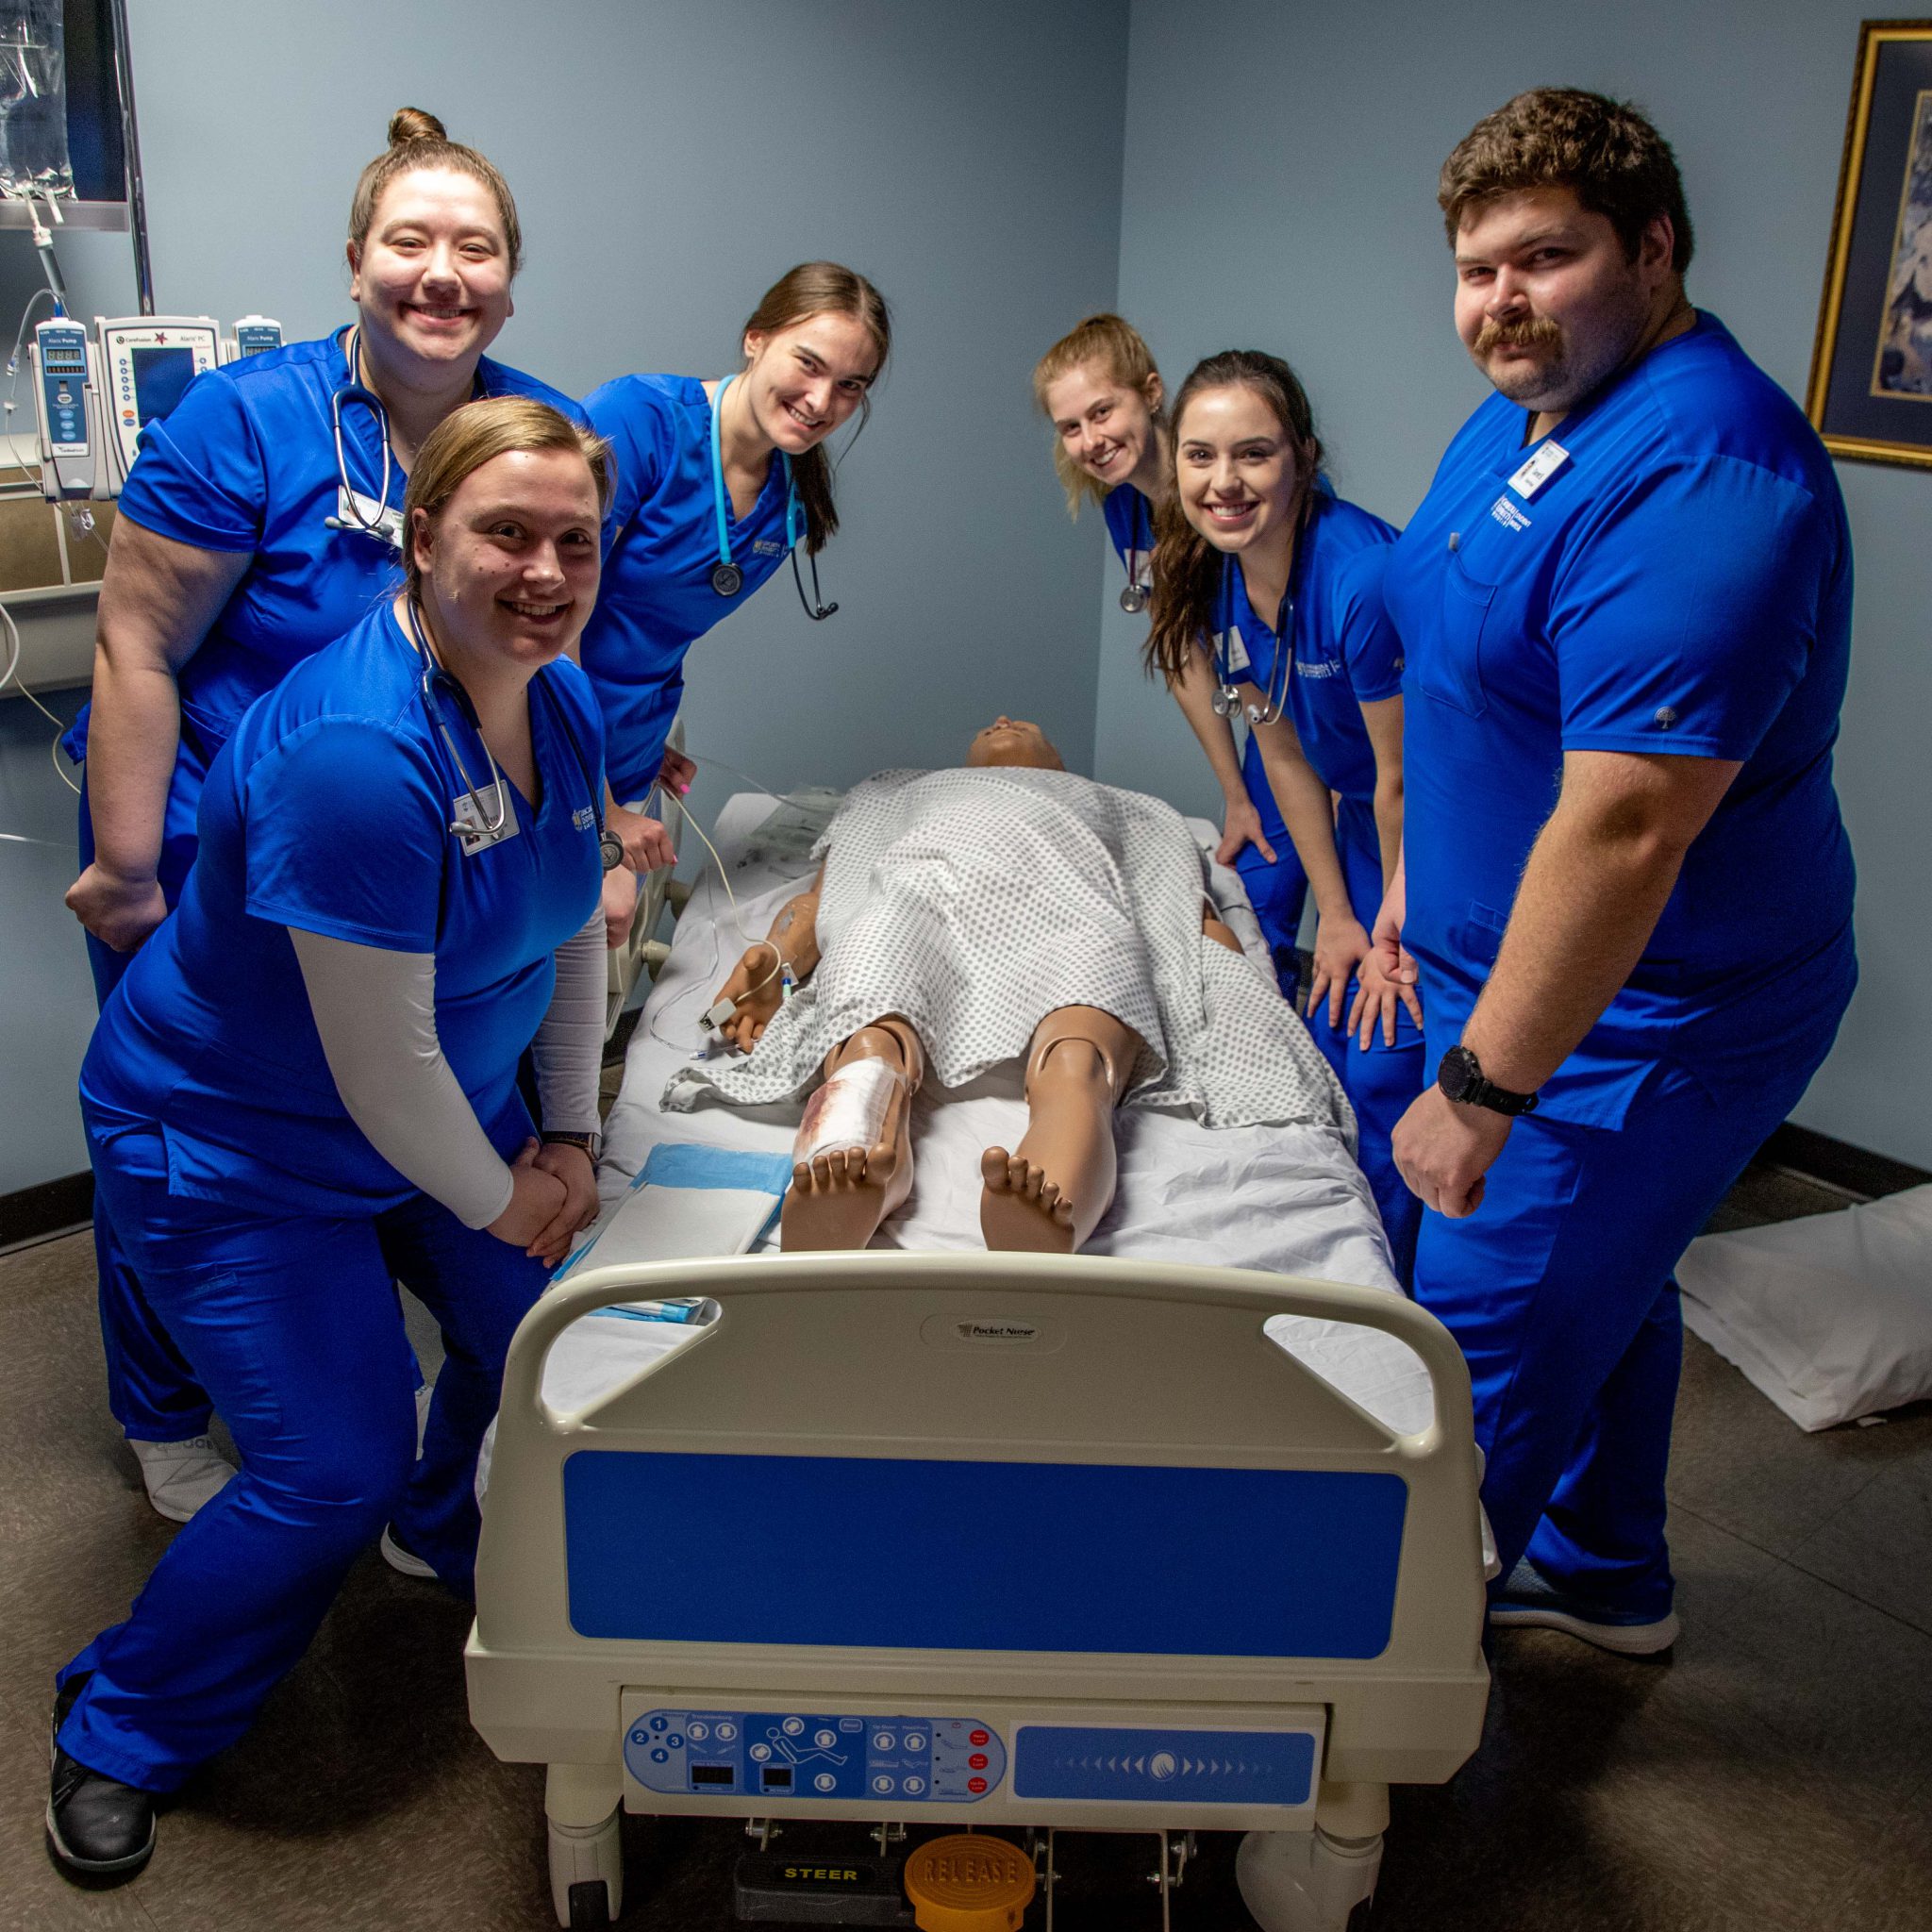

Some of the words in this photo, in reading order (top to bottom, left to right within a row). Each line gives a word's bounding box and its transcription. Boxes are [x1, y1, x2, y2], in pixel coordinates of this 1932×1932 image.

[973, 1326, 1004, 1335] Pocket
[655, 1720, 661, 1729] 1
[636, 1733, 644, 1742] 2
[671, 1736, 679, 1745] 3
[655, 1751, 663, 1760] 4
[785, 1868, 858, 1881] STEER
[924, 1858, 1017, 1884] RELEASE
